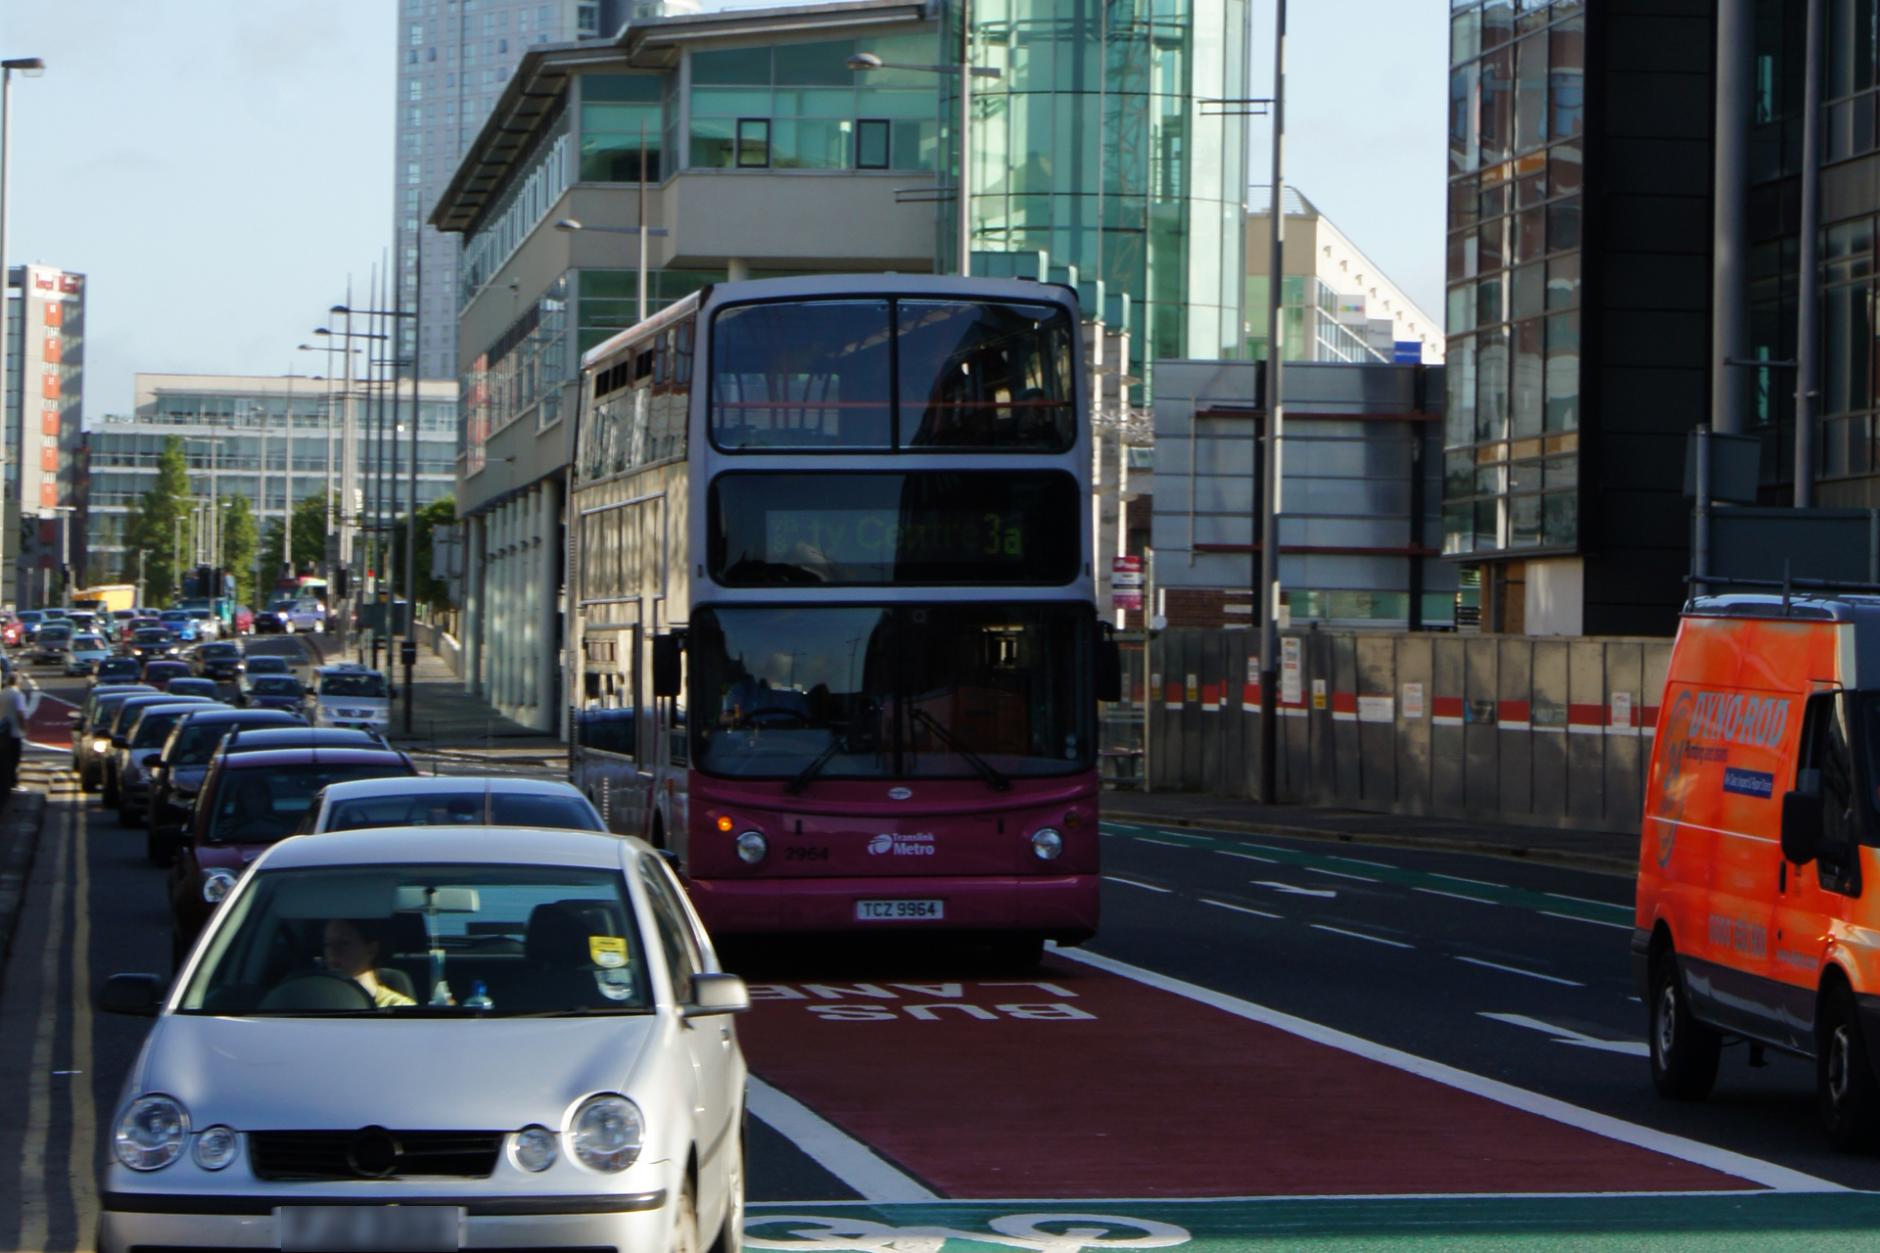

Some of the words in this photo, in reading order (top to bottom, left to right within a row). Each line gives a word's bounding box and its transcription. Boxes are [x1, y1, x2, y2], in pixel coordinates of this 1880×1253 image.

[983, 512, 1024, 555] 3a
[1688, 690, 1790, 748] DYNO-ROD
[893, 843, 935, 856] Metro
[863, 902, 893, 917] TCZ
[897, 902, 937, 917] 9964
[747, 983, 1080, 1000] LANE
[806, 1003, 1099, 1021] BUS
